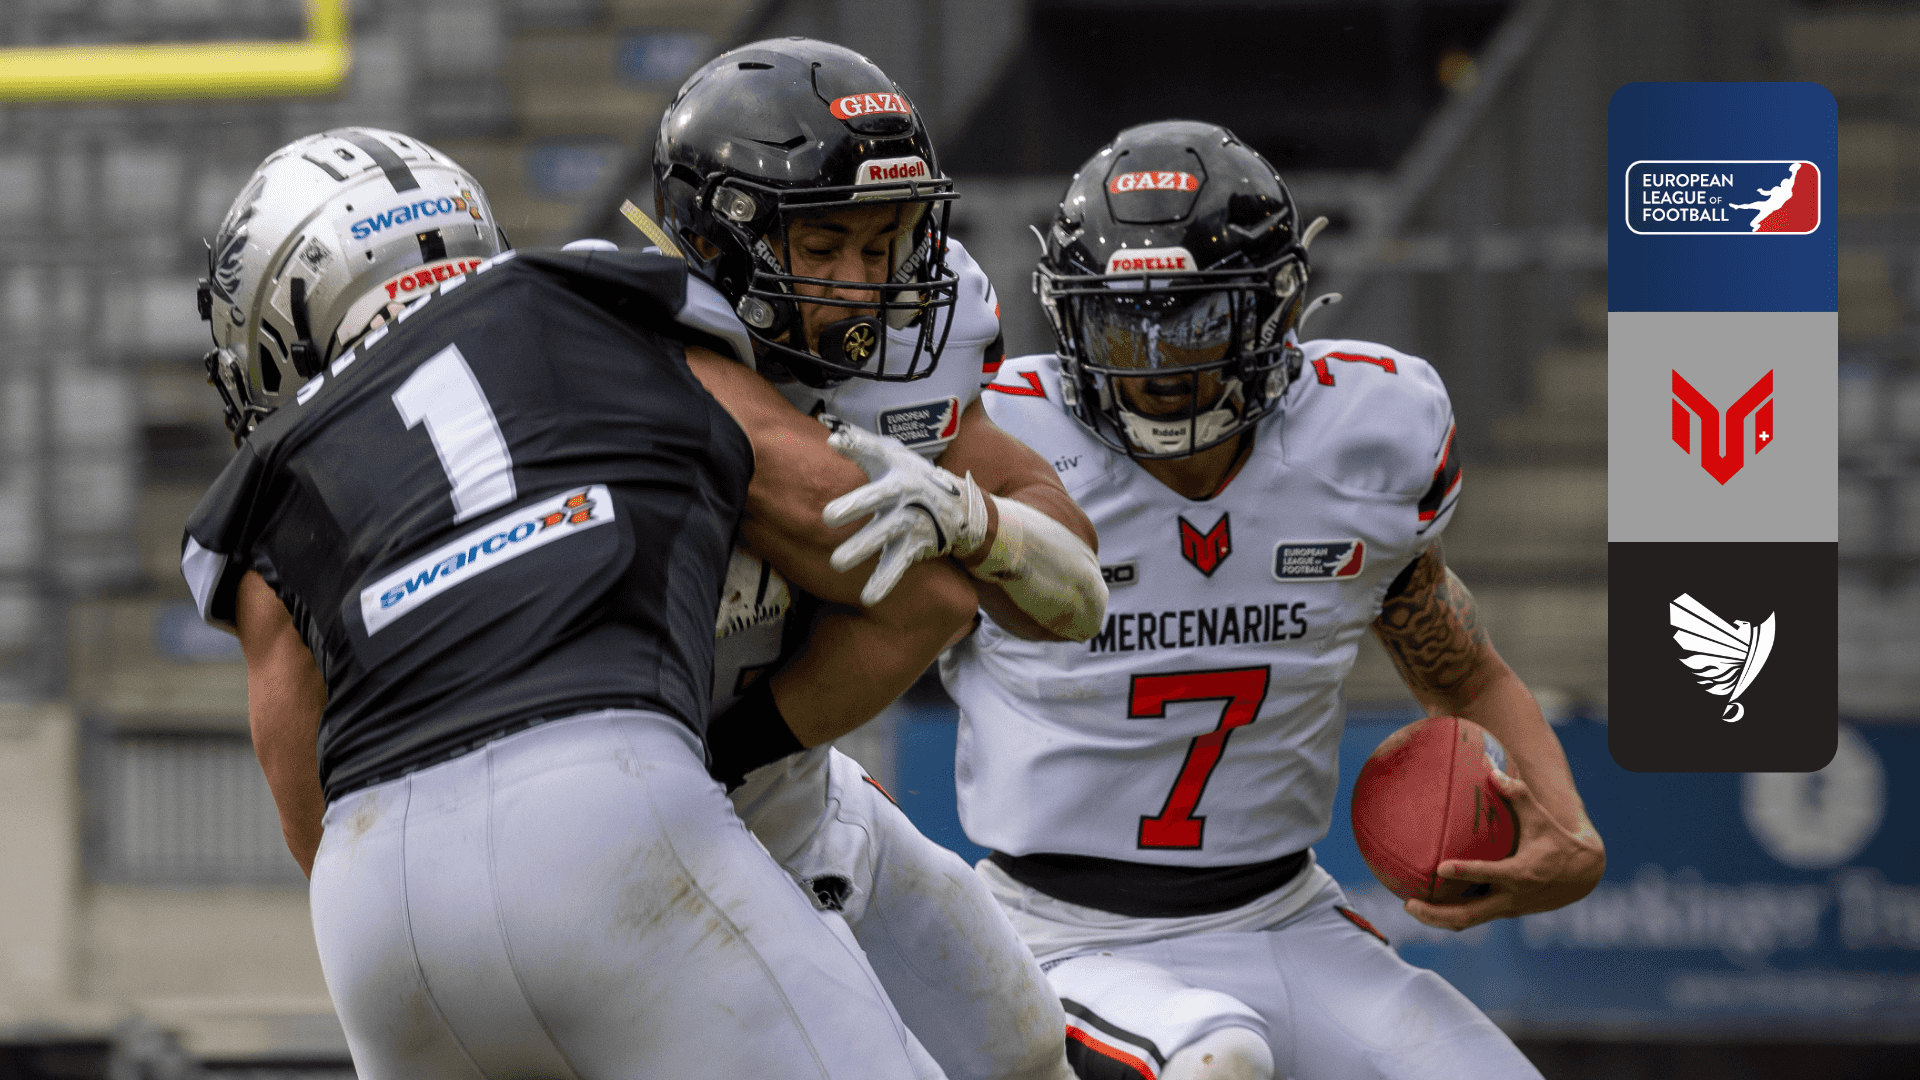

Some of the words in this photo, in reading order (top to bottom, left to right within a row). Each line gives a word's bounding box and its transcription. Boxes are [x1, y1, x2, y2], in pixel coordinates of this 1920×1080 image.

[839, 93, 908, 117] GAZI
[868, 161, 925, 180] Riddell
[1116, 171, 1190, 192] GAZI
[350, 196, 453, 240] swarco
[1112, 256, 1186, 272] FORELLE
[391, 342, 517, 526] 1
[1283, 547, 1328, 557] EUROPEAN
[1283, 556, 1315, 565] LEAGUE
[379, 521, 536, 610] swarco
[1282, 565, 1324, 574] FOOTBALL
[1090, 602, 1308, 653] MERCENARIES
[1127, 664, 1271, 850] 7
